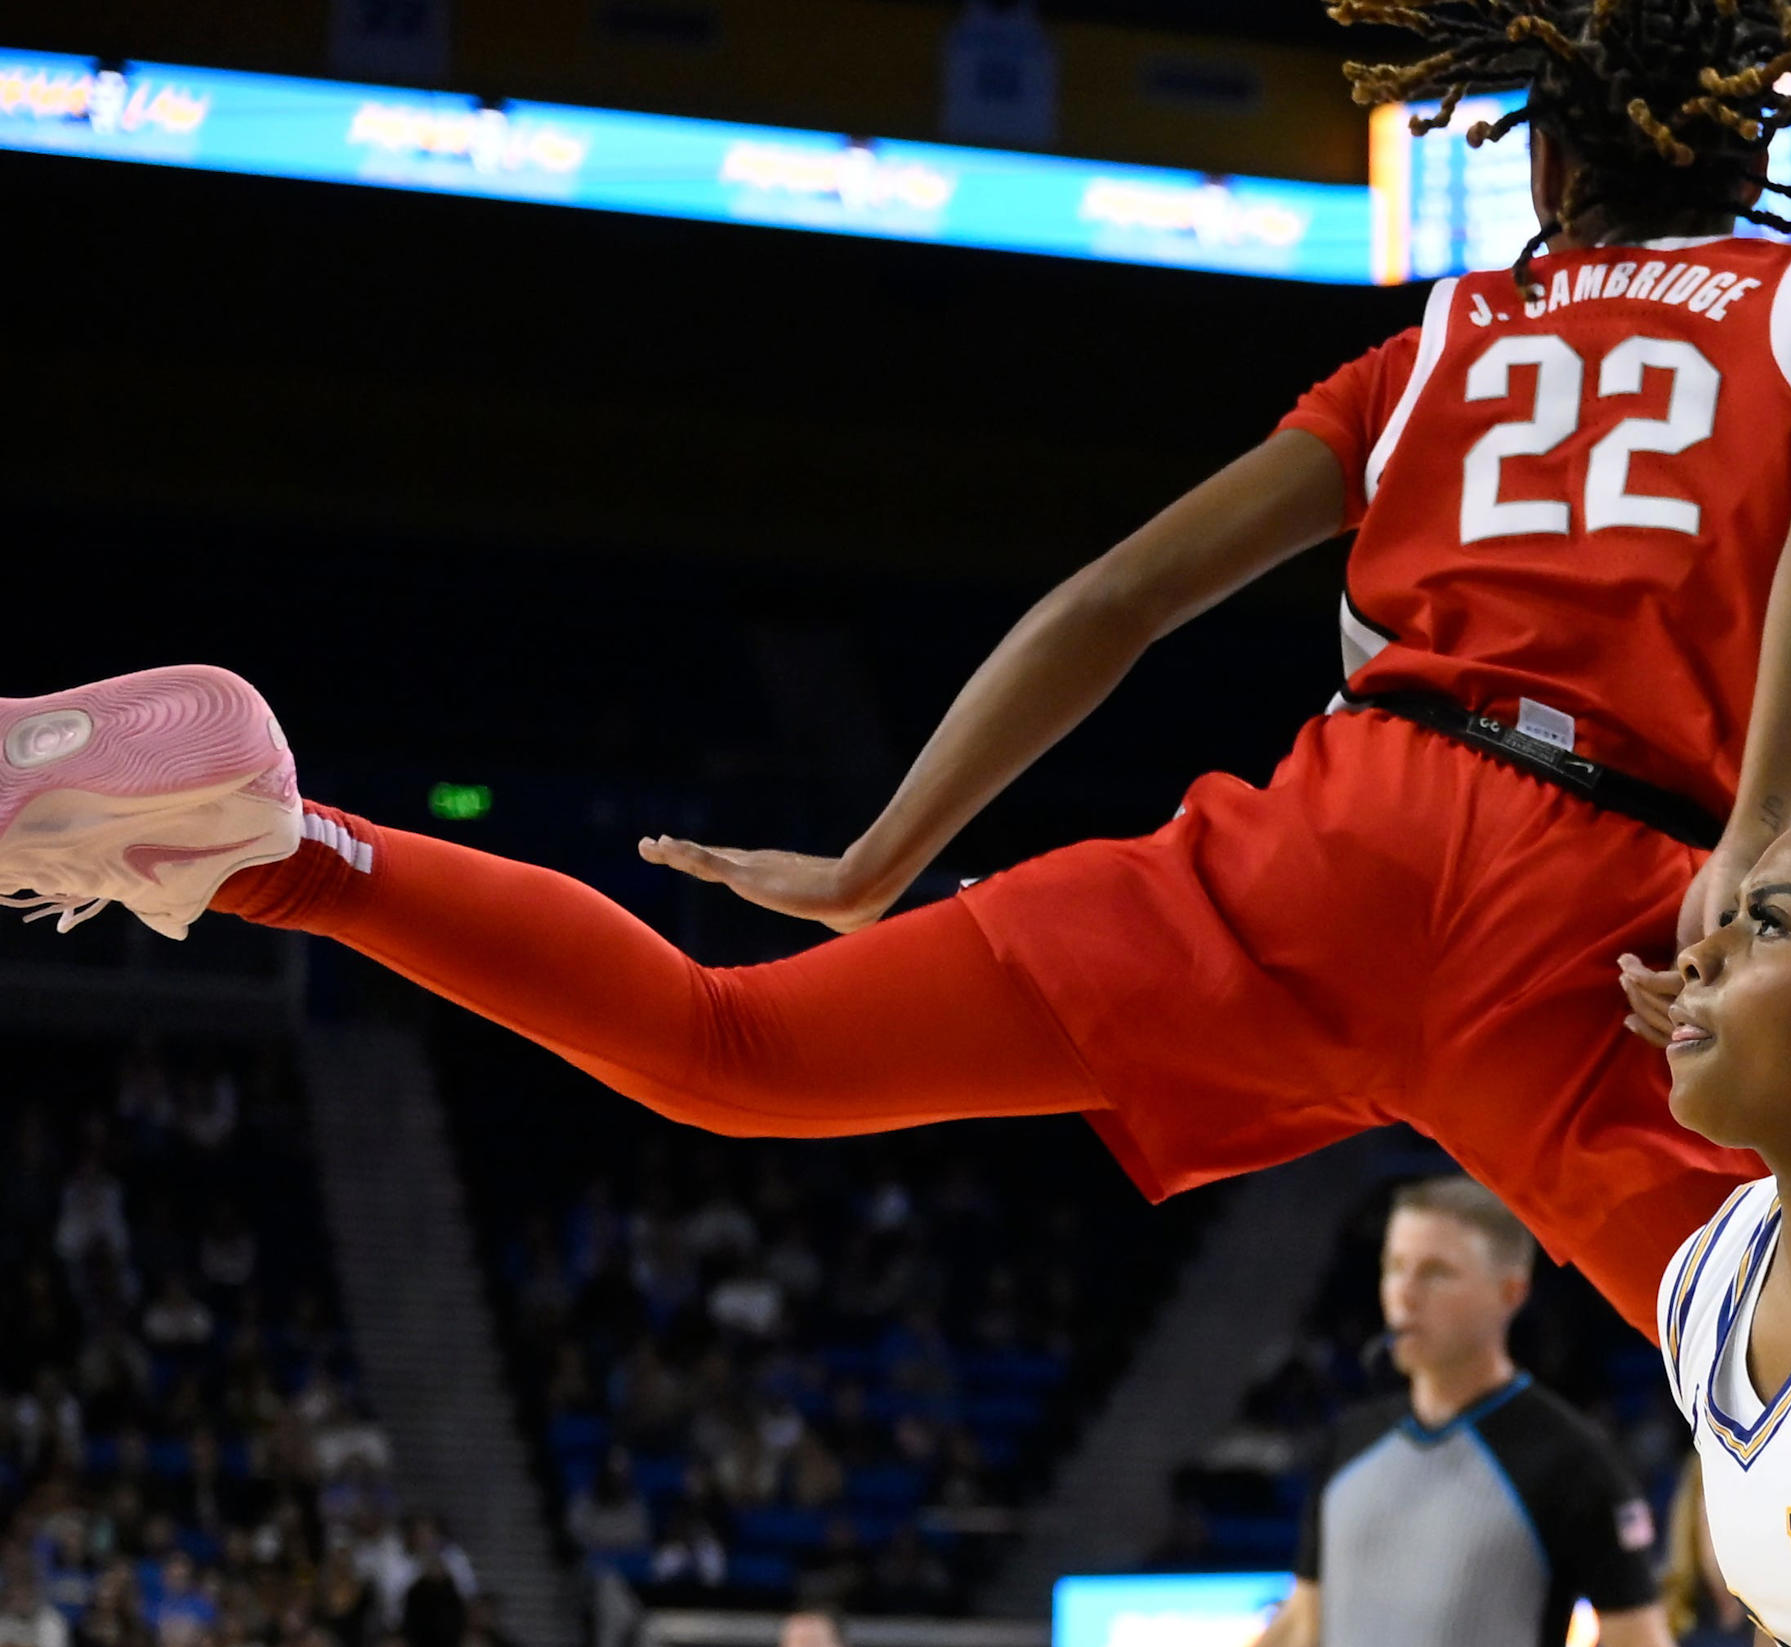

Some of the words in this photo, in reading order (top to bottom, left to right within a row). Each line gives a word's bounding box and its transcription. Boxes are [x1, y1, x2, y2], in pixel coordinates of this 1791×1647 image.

[1469, 292, 1511, 328] J.
[1523, 260, 1762, 323] CAMBRIDGE
[1460, 334, 1722, 546] 22
